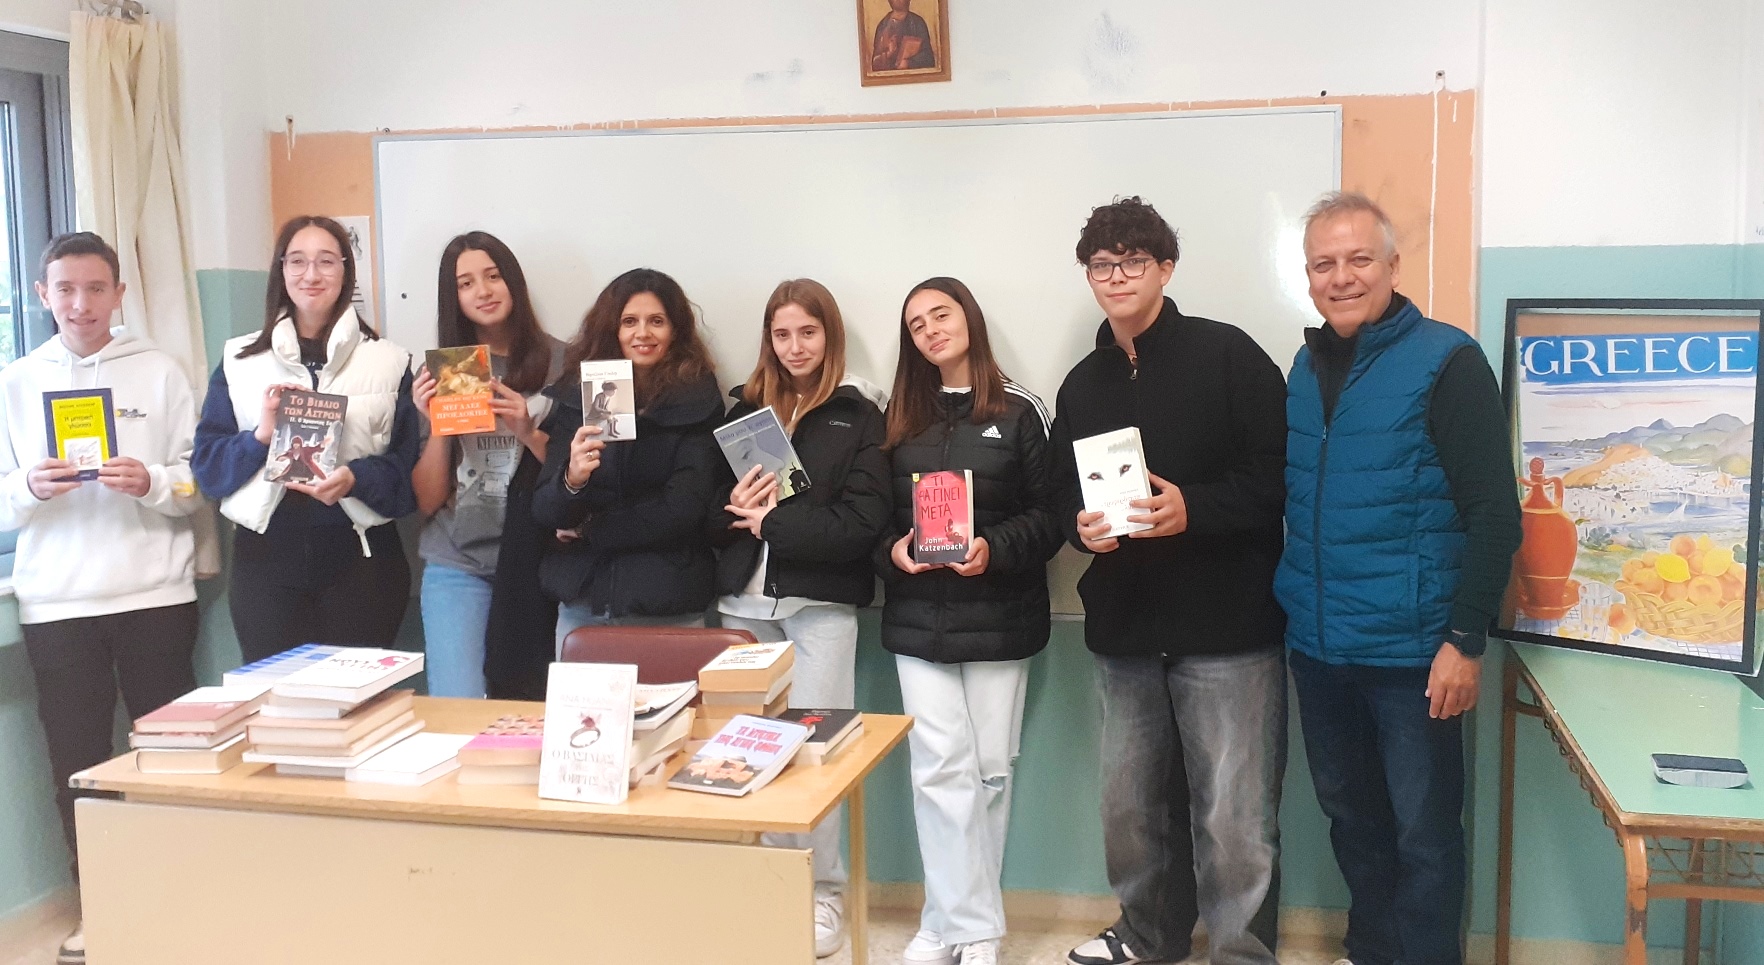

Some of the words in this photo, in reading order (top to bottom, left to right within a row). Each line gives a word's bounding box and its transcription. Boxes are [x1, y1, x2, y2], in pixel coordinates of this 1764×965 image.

[1524, 336, 1754, 377] GREECE
[930, 474, 944, 487] ΤΙ
[933, 487, 961, 502] ΓΙΝΕΙ
[921, 503, 952, 520] ΜΕΤΑ
[919, 543, 964, 552] Katzenbach
